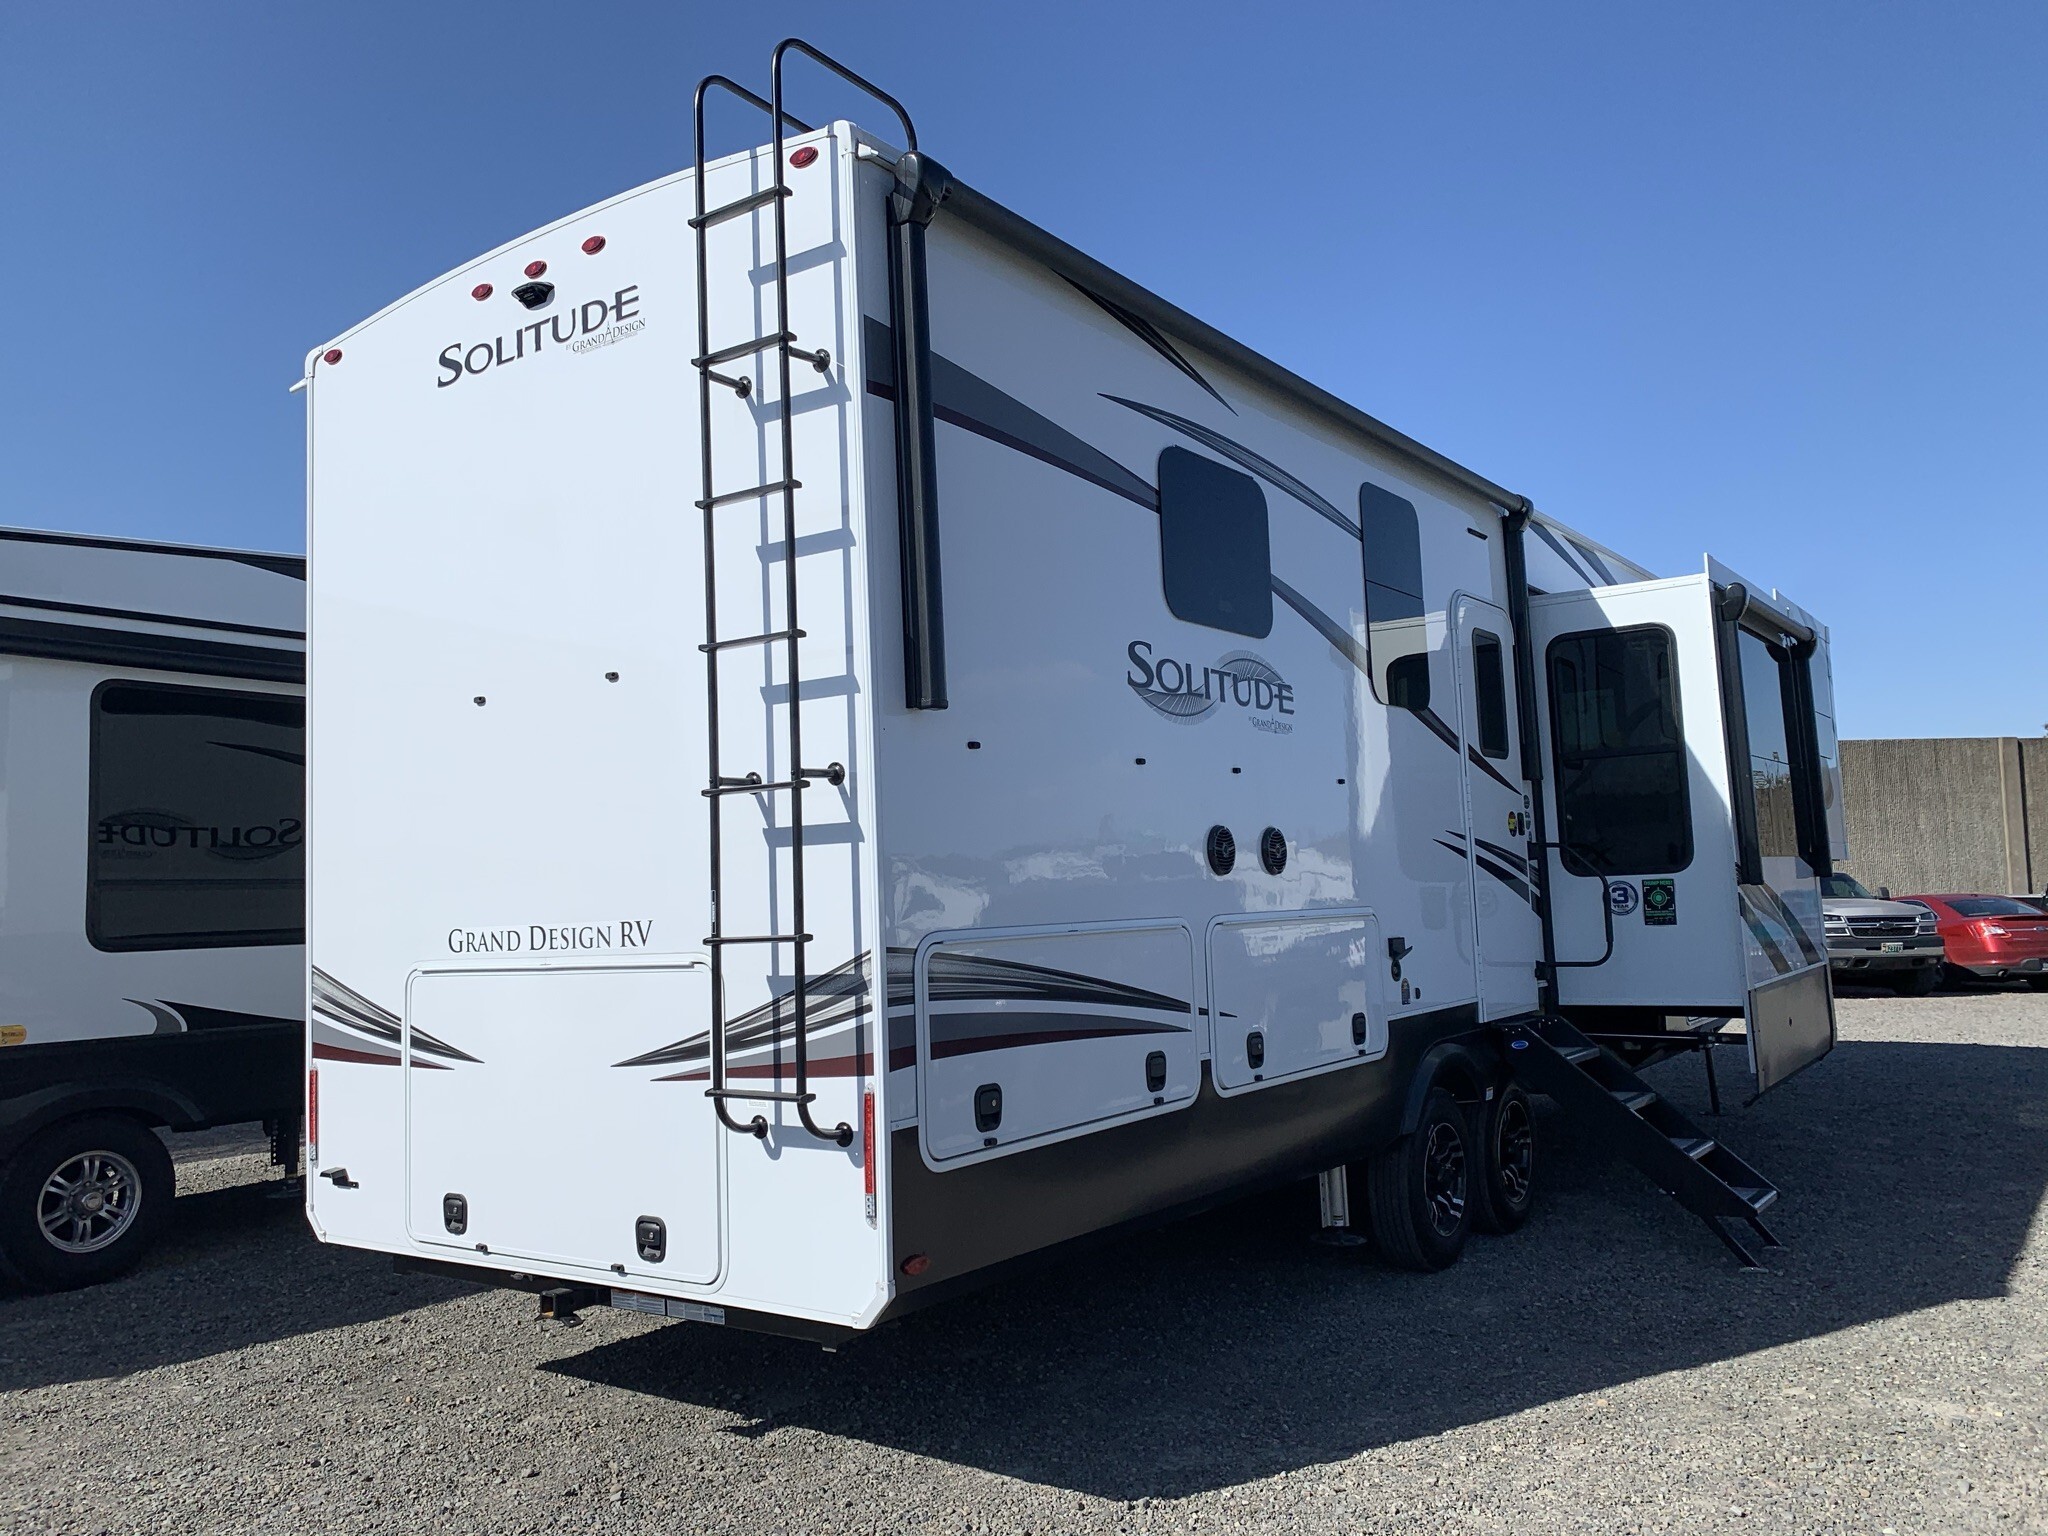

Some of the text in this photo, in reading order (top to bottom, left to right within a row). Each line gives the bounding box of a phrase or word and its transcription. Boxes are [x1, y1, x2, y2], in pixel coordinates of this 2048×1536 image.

[437, 284, 640, 388] SOLITUDE
[572, 333, 605, 352] GRAND
[612, 317, 646, 338] DESIGN
[1127, 640, 1295, 715] SOLITUDE
[1612, 887, 1629, 904] 3
[448, 919, 654, 953] GRAND DESIGN RV
